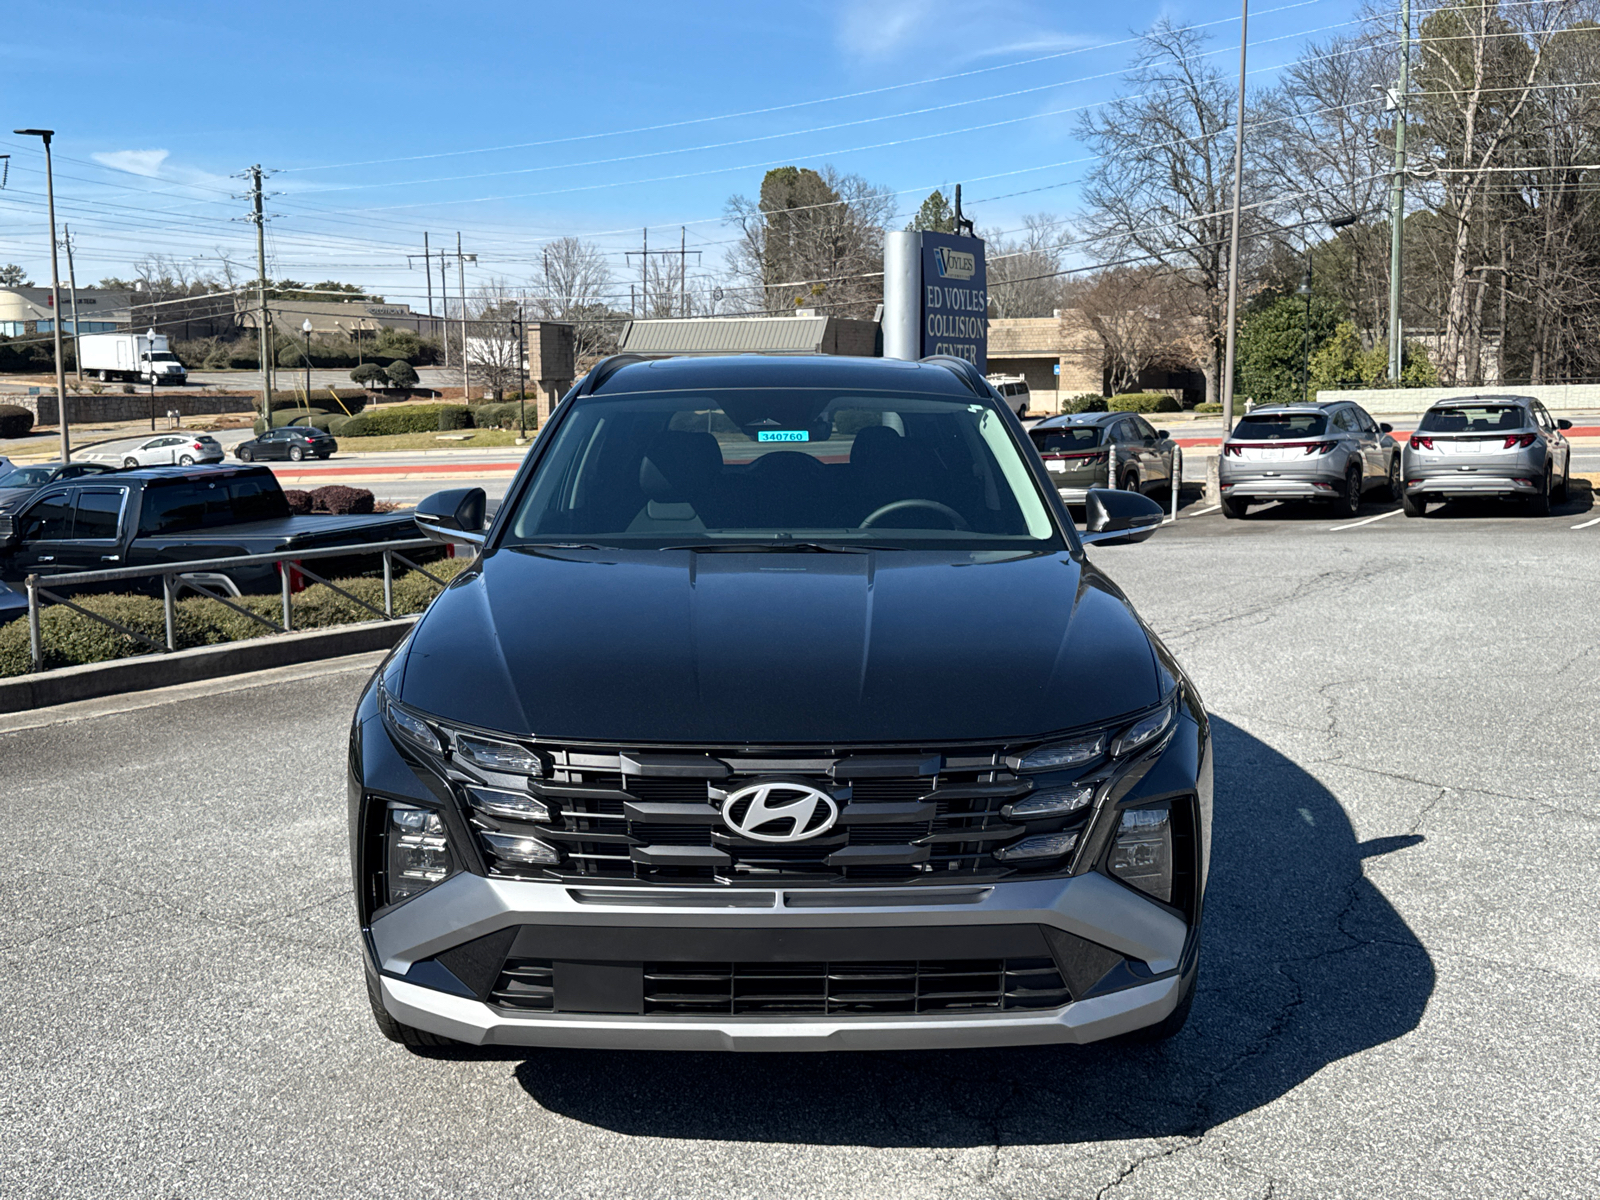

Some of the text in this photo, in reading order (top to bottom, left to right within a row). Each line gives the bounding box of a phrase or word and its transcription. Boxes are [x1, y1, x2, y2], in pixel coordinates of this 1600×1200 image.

[939, 248, 973, 274] VOYLES
[927, 285, 985, 312] ED VOYLES
[927, 313, 985, 339] COLLISION
[762, 433, 803, 441] 340760
